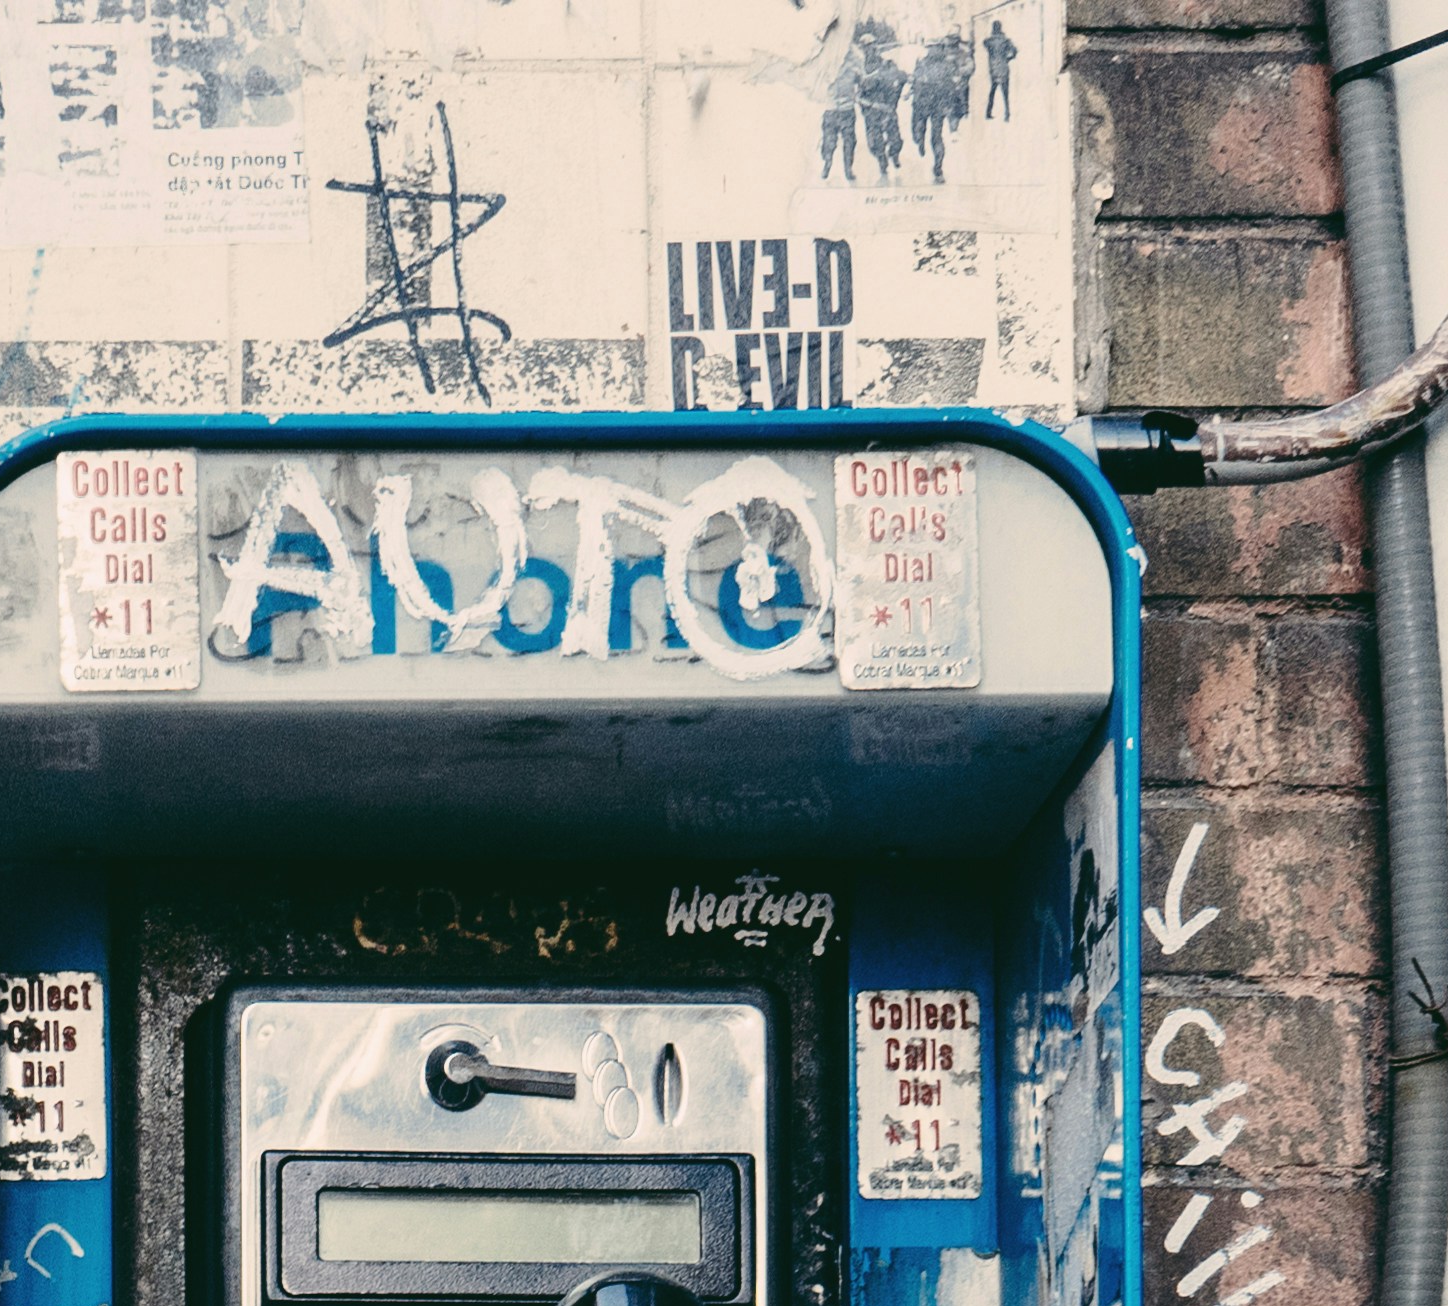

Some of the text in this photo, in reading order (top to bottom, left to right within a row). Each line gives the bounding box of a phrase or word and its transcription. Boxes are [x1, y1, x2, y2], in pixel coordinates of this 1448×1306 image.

[71, 460, 184, 497] Collect
[851, 459, 964, 497] Collect
[90, 506, 167, 544] Calls
[105, 554, 153, 584] Dial
[212, 455, 835, 681] AUTO
[884, 553, 933, 583] Dial
[150, 645, 171, 659] Por
[869, 997, 971, 1031] Collect
[7, 1019, 78, 1053] Calls
[885, 1038, 954, 1072] Calls
[22, 1060, 65, 1088] Dial
[898, 1079, 942, 1107] Dial
